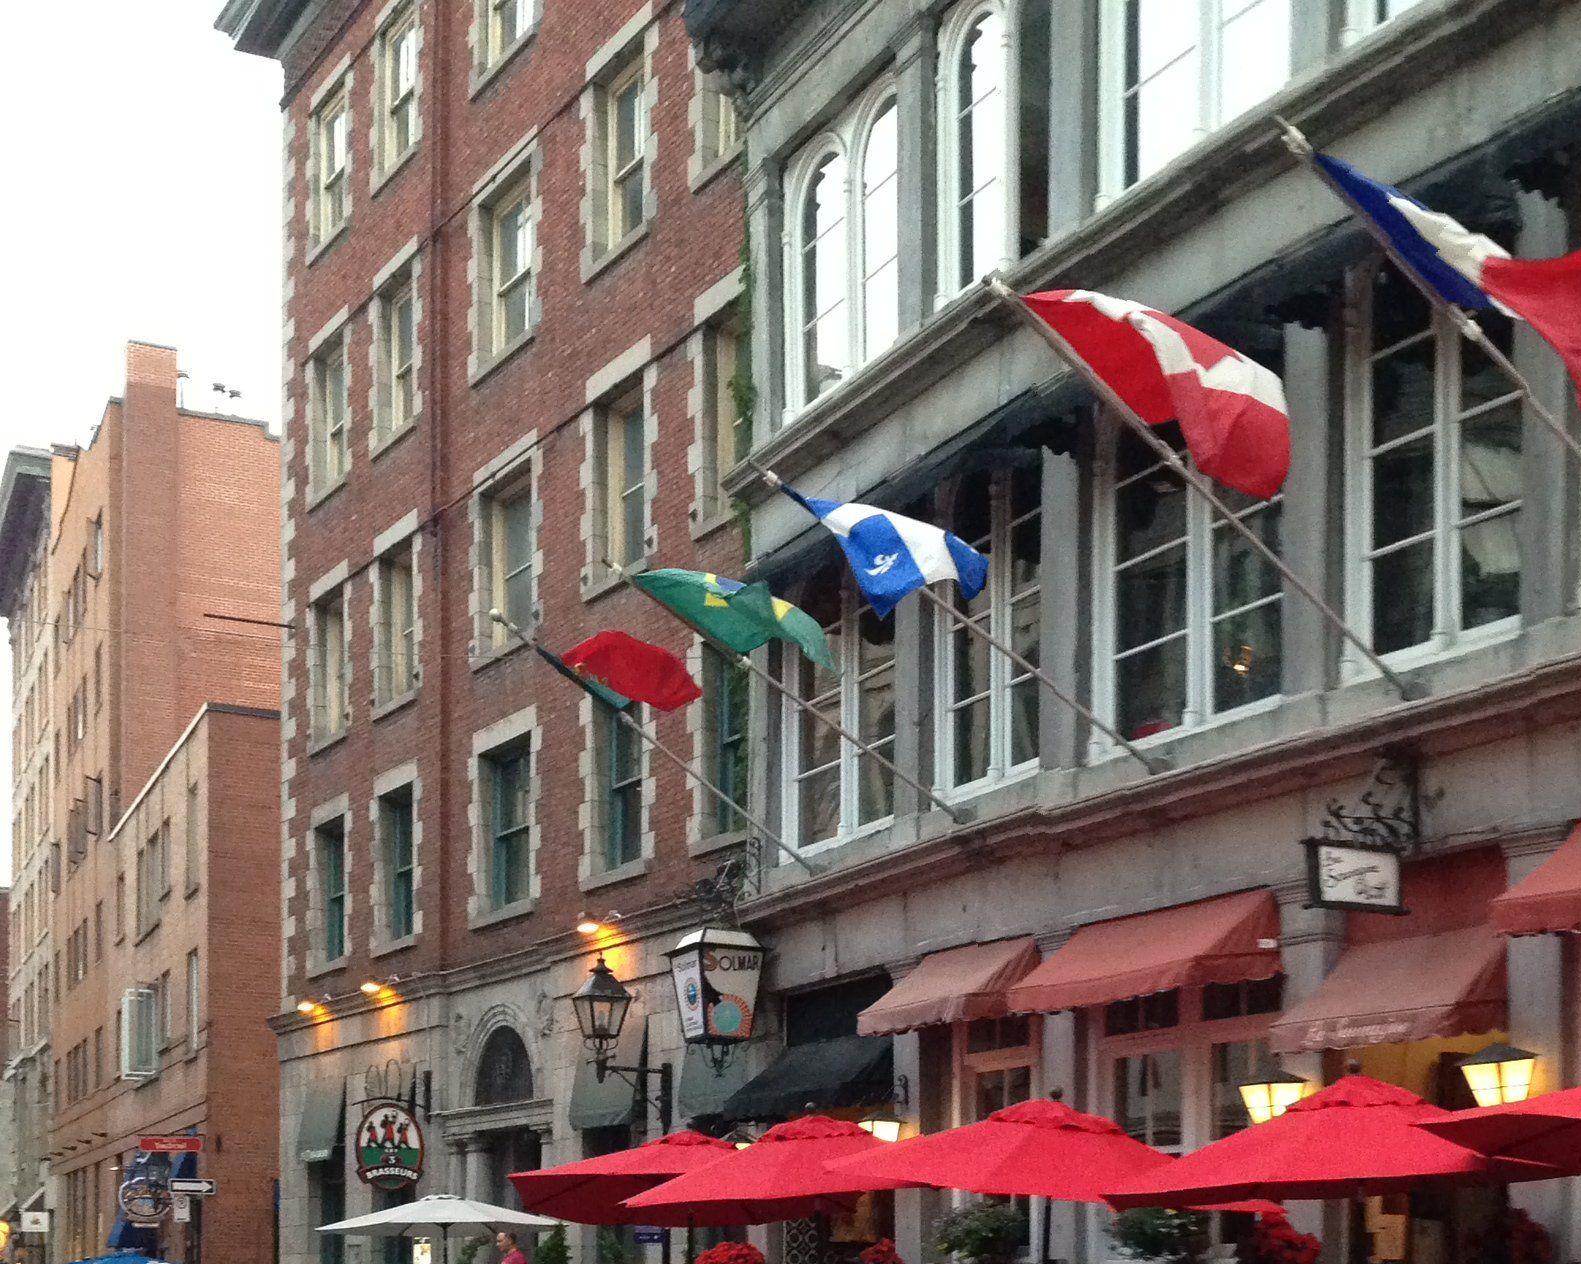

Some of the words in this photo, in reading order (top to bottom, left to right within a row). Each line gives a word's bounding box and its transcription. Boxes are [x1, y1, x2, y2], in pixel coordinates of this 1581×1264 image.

[703, 948, 760, 972] SOLMAR
[388, 1155, 396, 1165] 3
[365, 1166, 419, 1180] BRASSEURS
